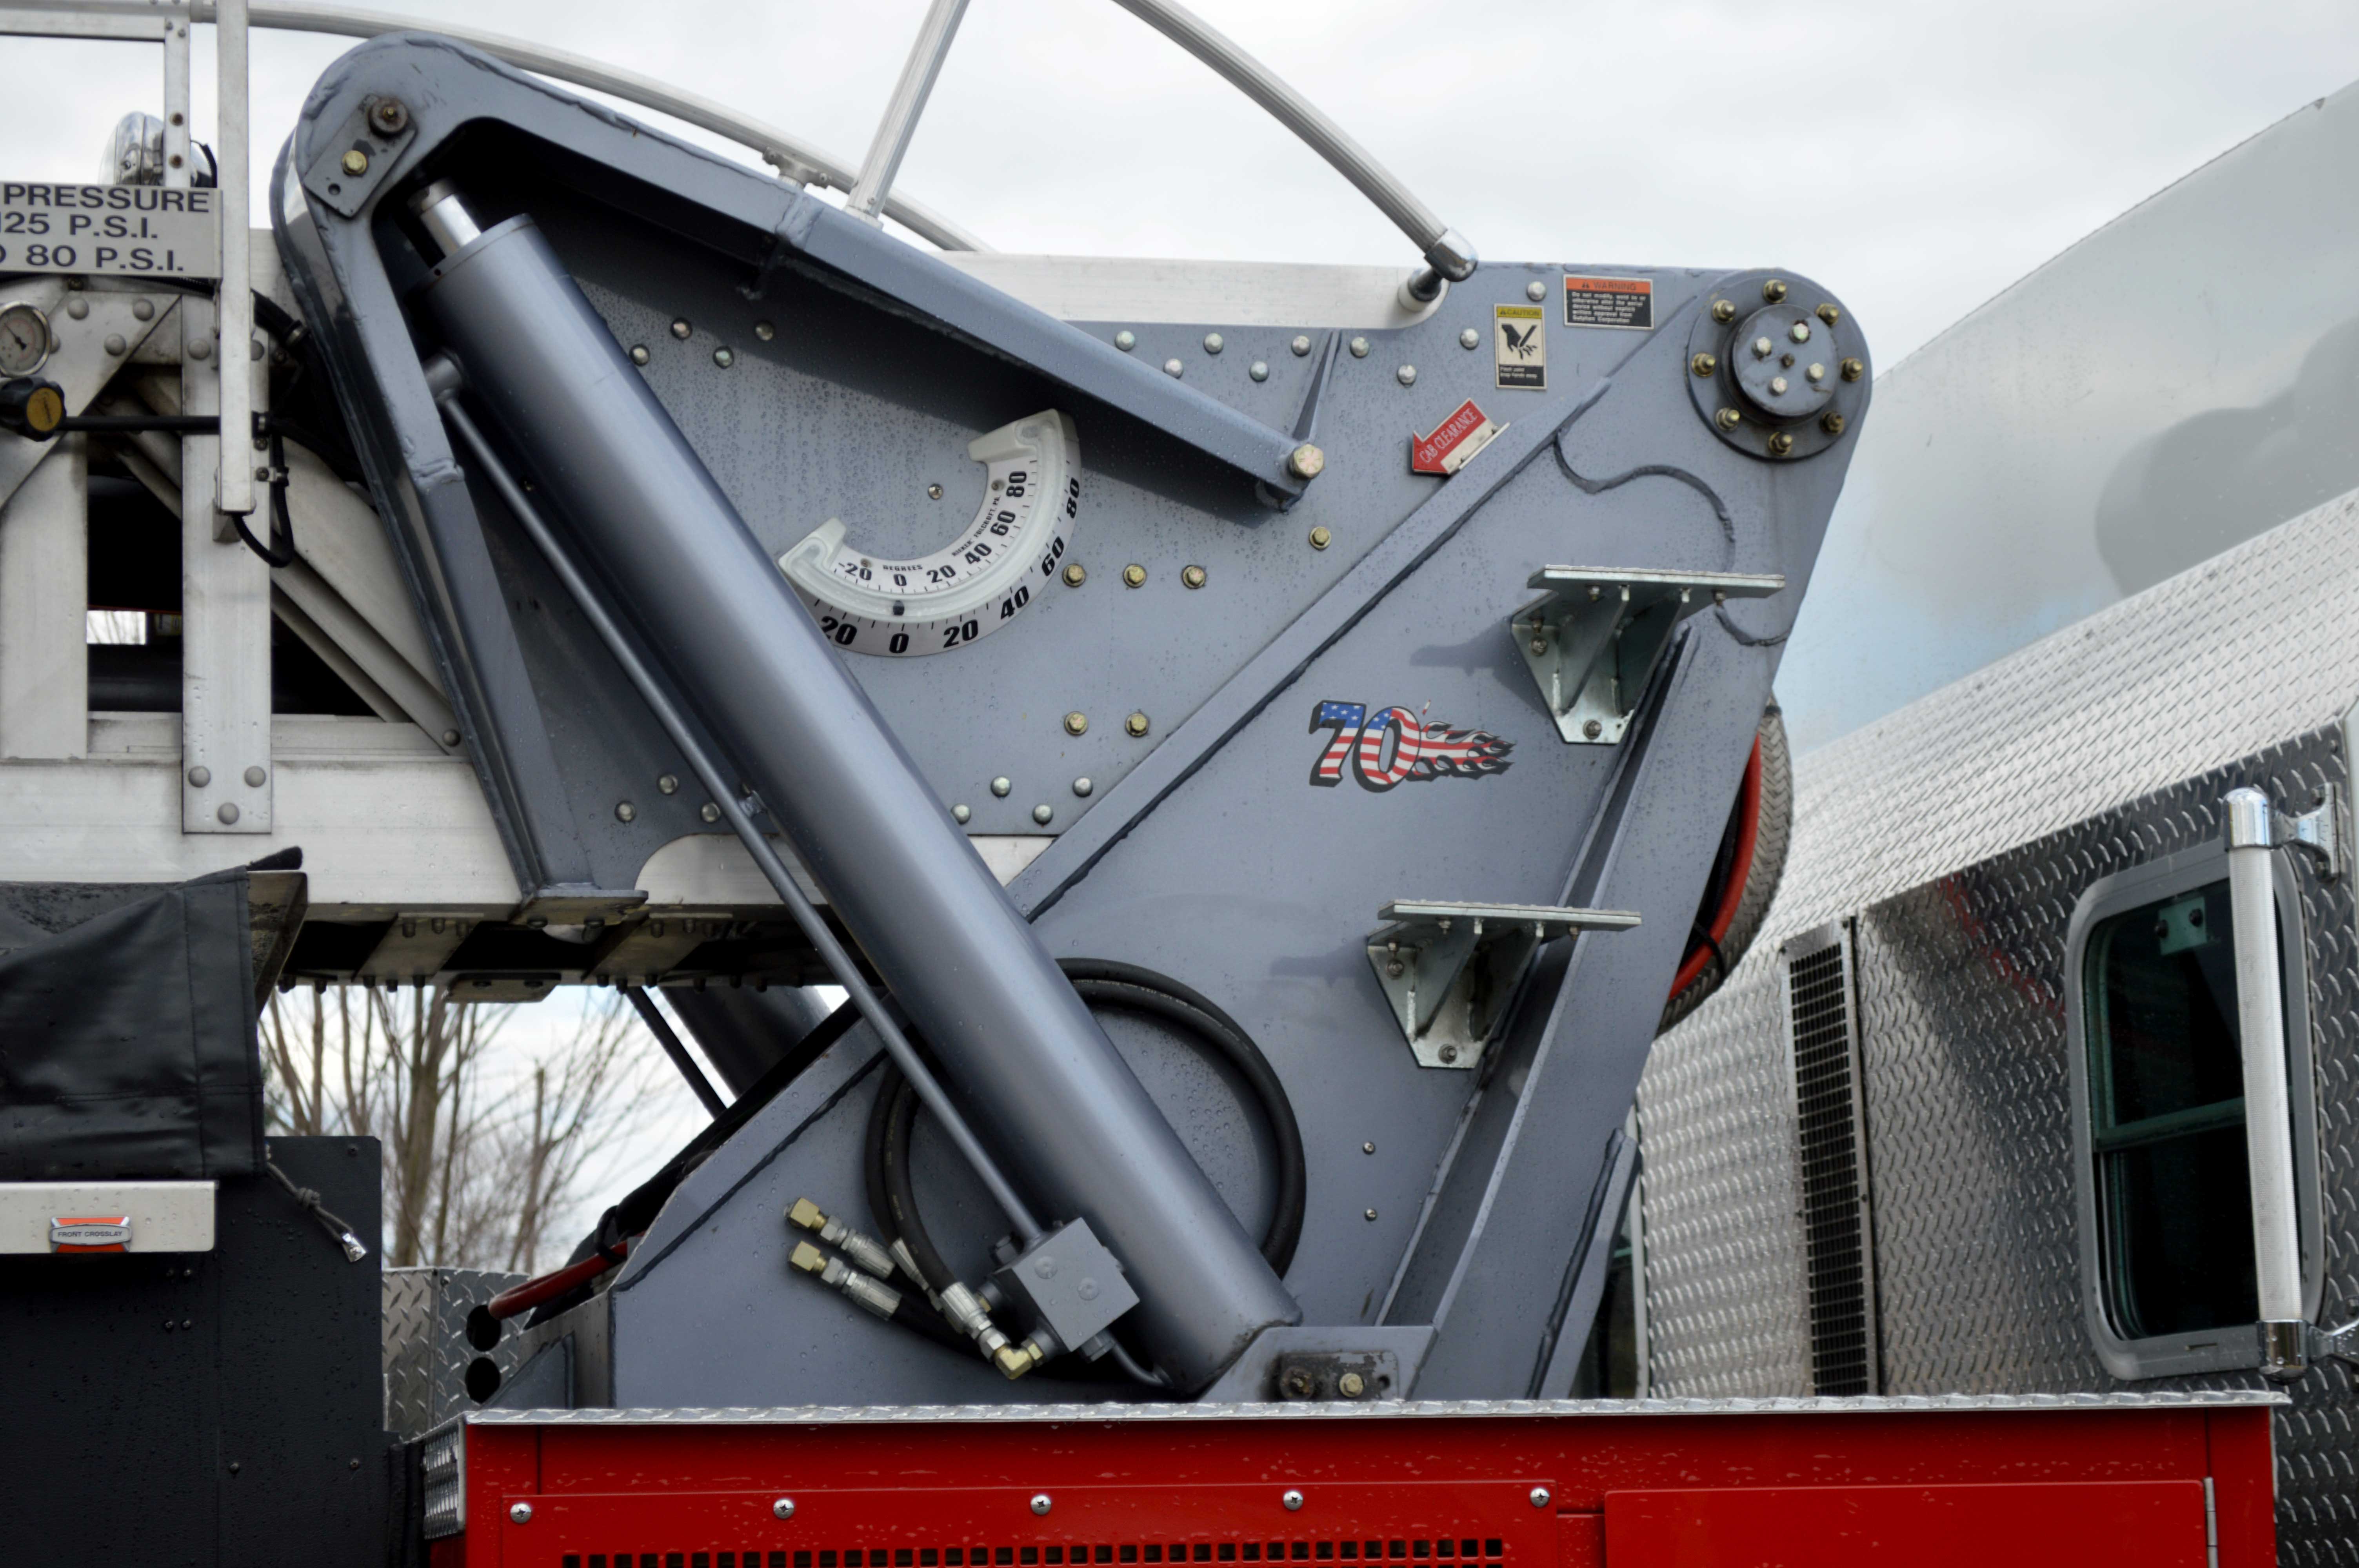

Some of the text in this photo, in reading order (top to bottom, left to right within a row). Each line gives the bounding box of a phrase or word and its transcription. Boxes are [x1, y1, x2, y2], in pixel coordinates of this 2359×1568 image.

[4, 184, 209, 212] PRESSURE
[0, 211, 158, 238] 25 P.S.I.
[25, 244, 76, 267] 80
[95, 247, 184, 271] P.S.I.
[1593, 282, 1636, 290] WARNING
[1419, 408, 1478, 464] CAB CLEARANCE
[893, 573, 907, 586] 0
[926, 564, 956, 583] 20
[965, 543, 992, 564] 40
[990, 510, 1016, 536] 60
[1006, 471, 1027, 498] 80
[889, 633, 909, 653] 0
[943, 619, 978, 648] 20
[1000, 585, 1029, 620] 40
[1041, 536, 1064, 577] 60
[1066, 477, 1080, 519] 80
